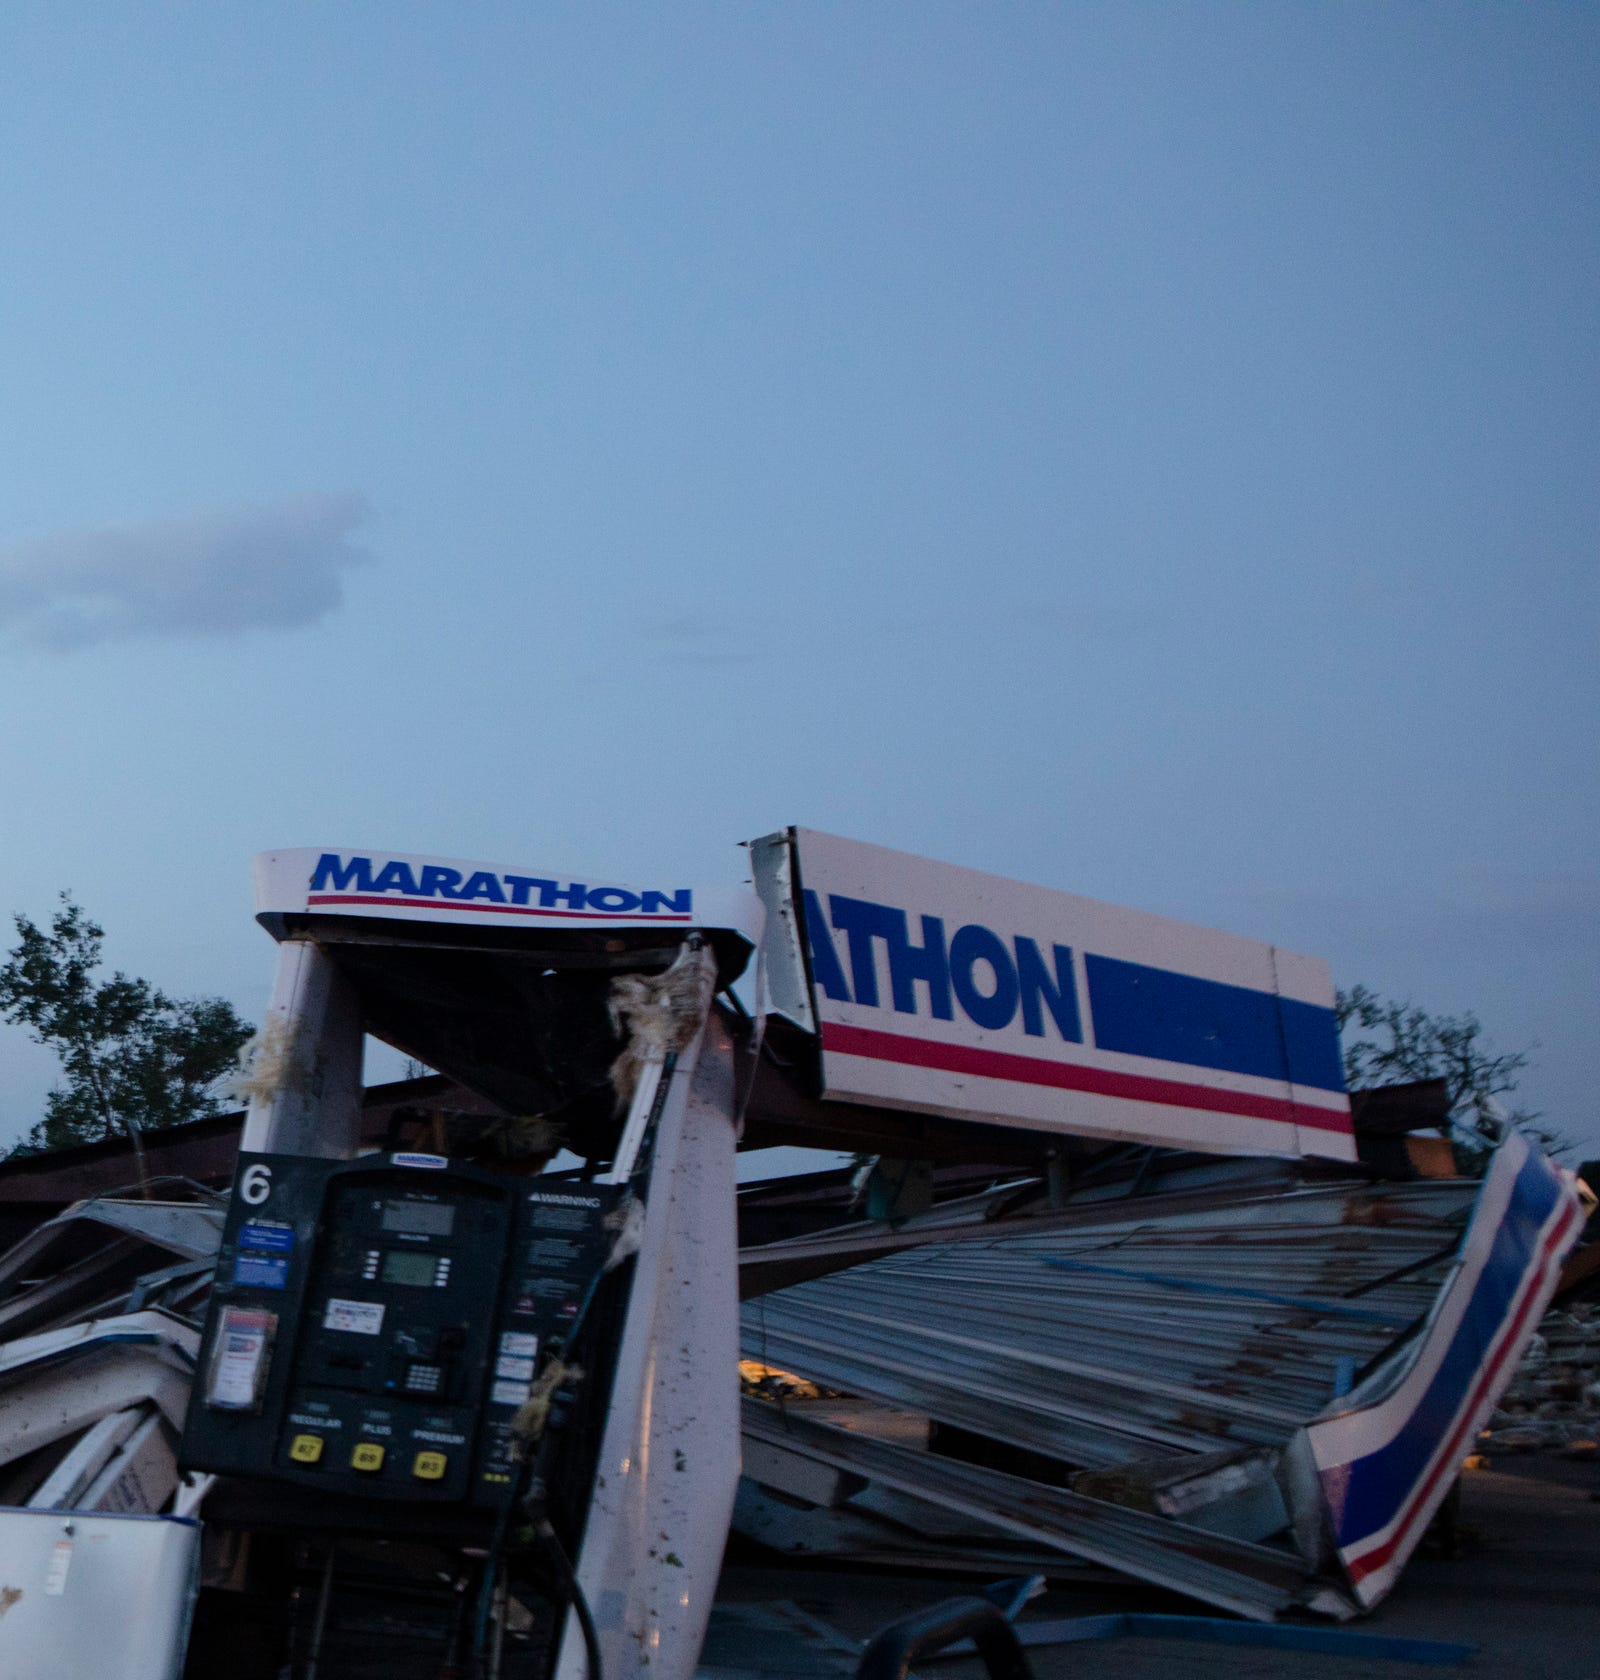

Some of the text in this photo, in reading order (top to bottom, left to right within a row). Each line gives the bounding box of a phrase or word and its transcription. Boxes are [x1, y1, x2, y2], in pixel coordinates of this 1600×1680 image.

[309, 853, 692, 913] MARATHON
[239, 1163, 272, 1206] 6
[541, 1192, 601, 1209] WARNING
